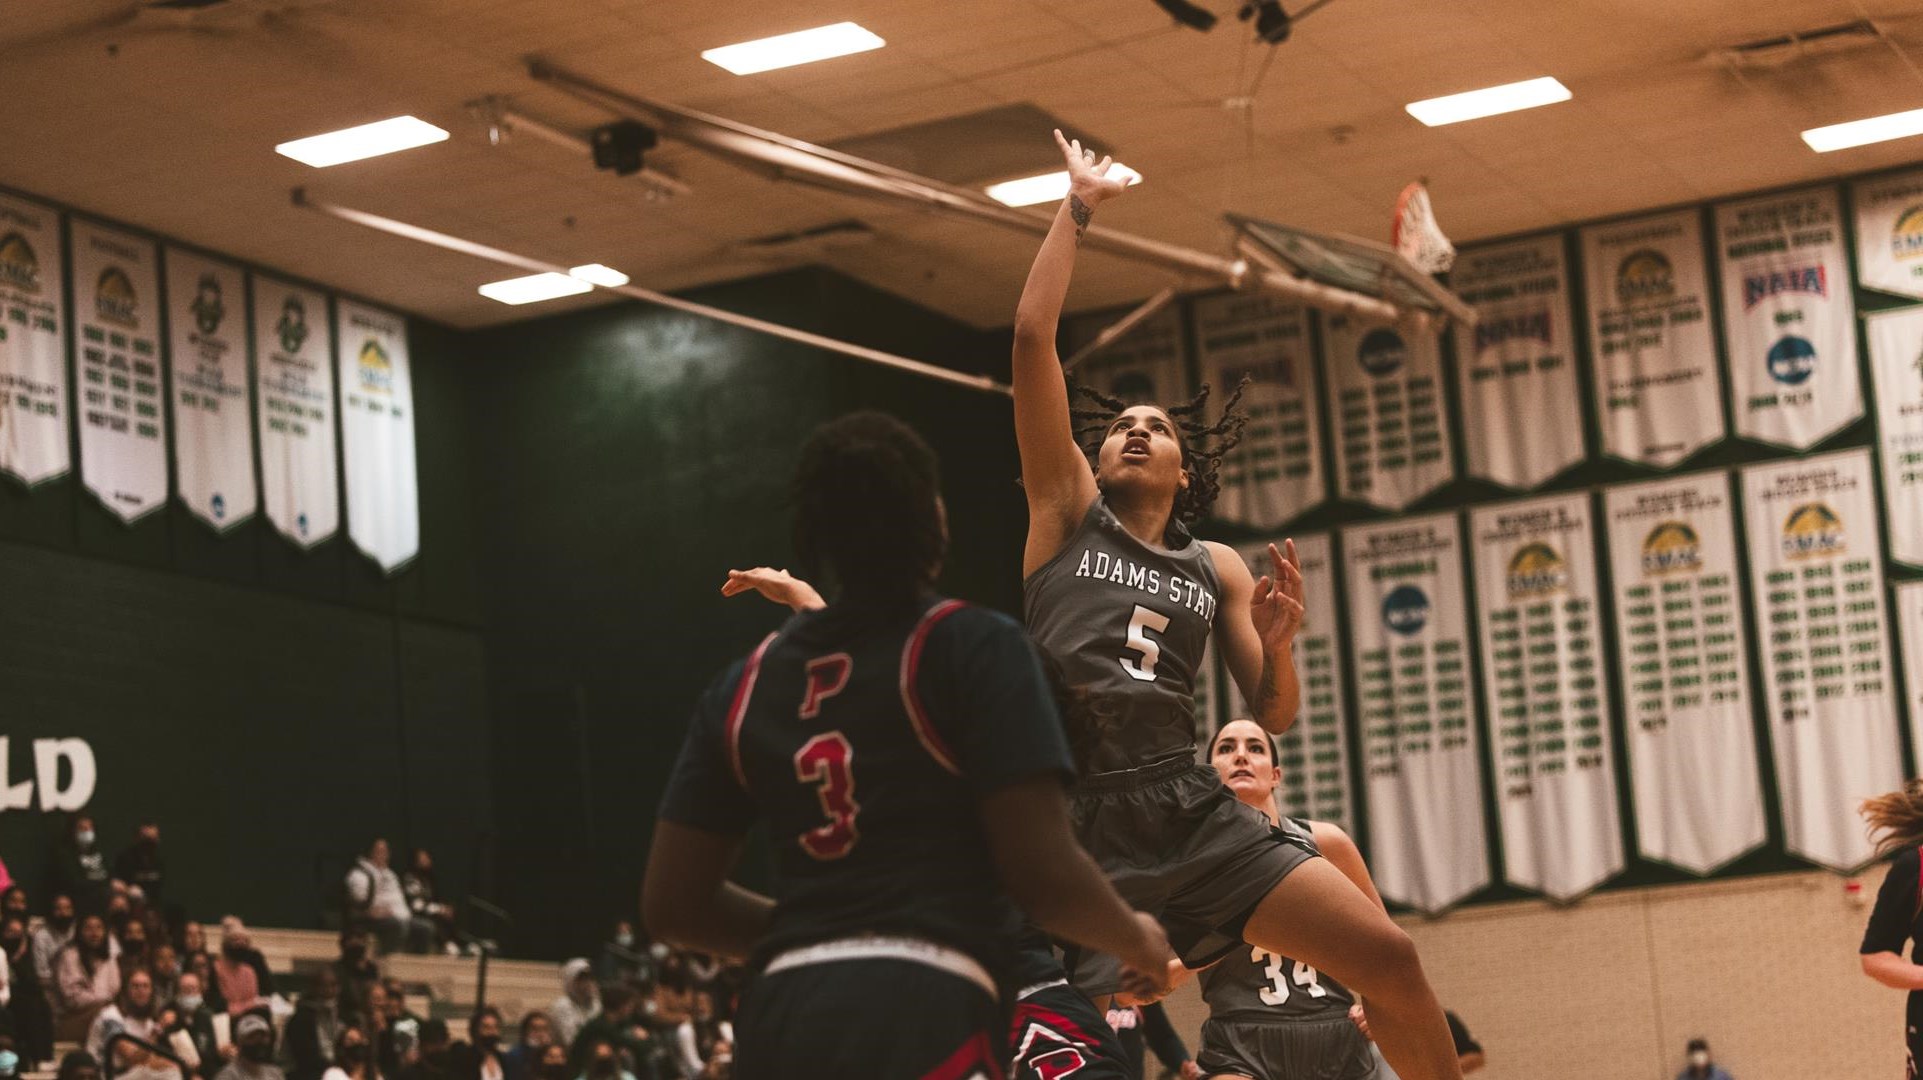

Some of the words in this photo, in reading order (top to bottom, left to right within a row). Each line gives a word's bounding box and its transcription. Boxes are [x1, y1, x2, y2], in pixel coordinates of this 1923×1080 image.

[1743, 265, 1825, 311] NAIA
[1075, 549, 1160, 595] ADAMS
[1118, 604, 1171, 682] 5
[798, 651, 854, 720] P
[793, 729, 861, 861] 3
[1250, 945, 1327, 1007] 34
